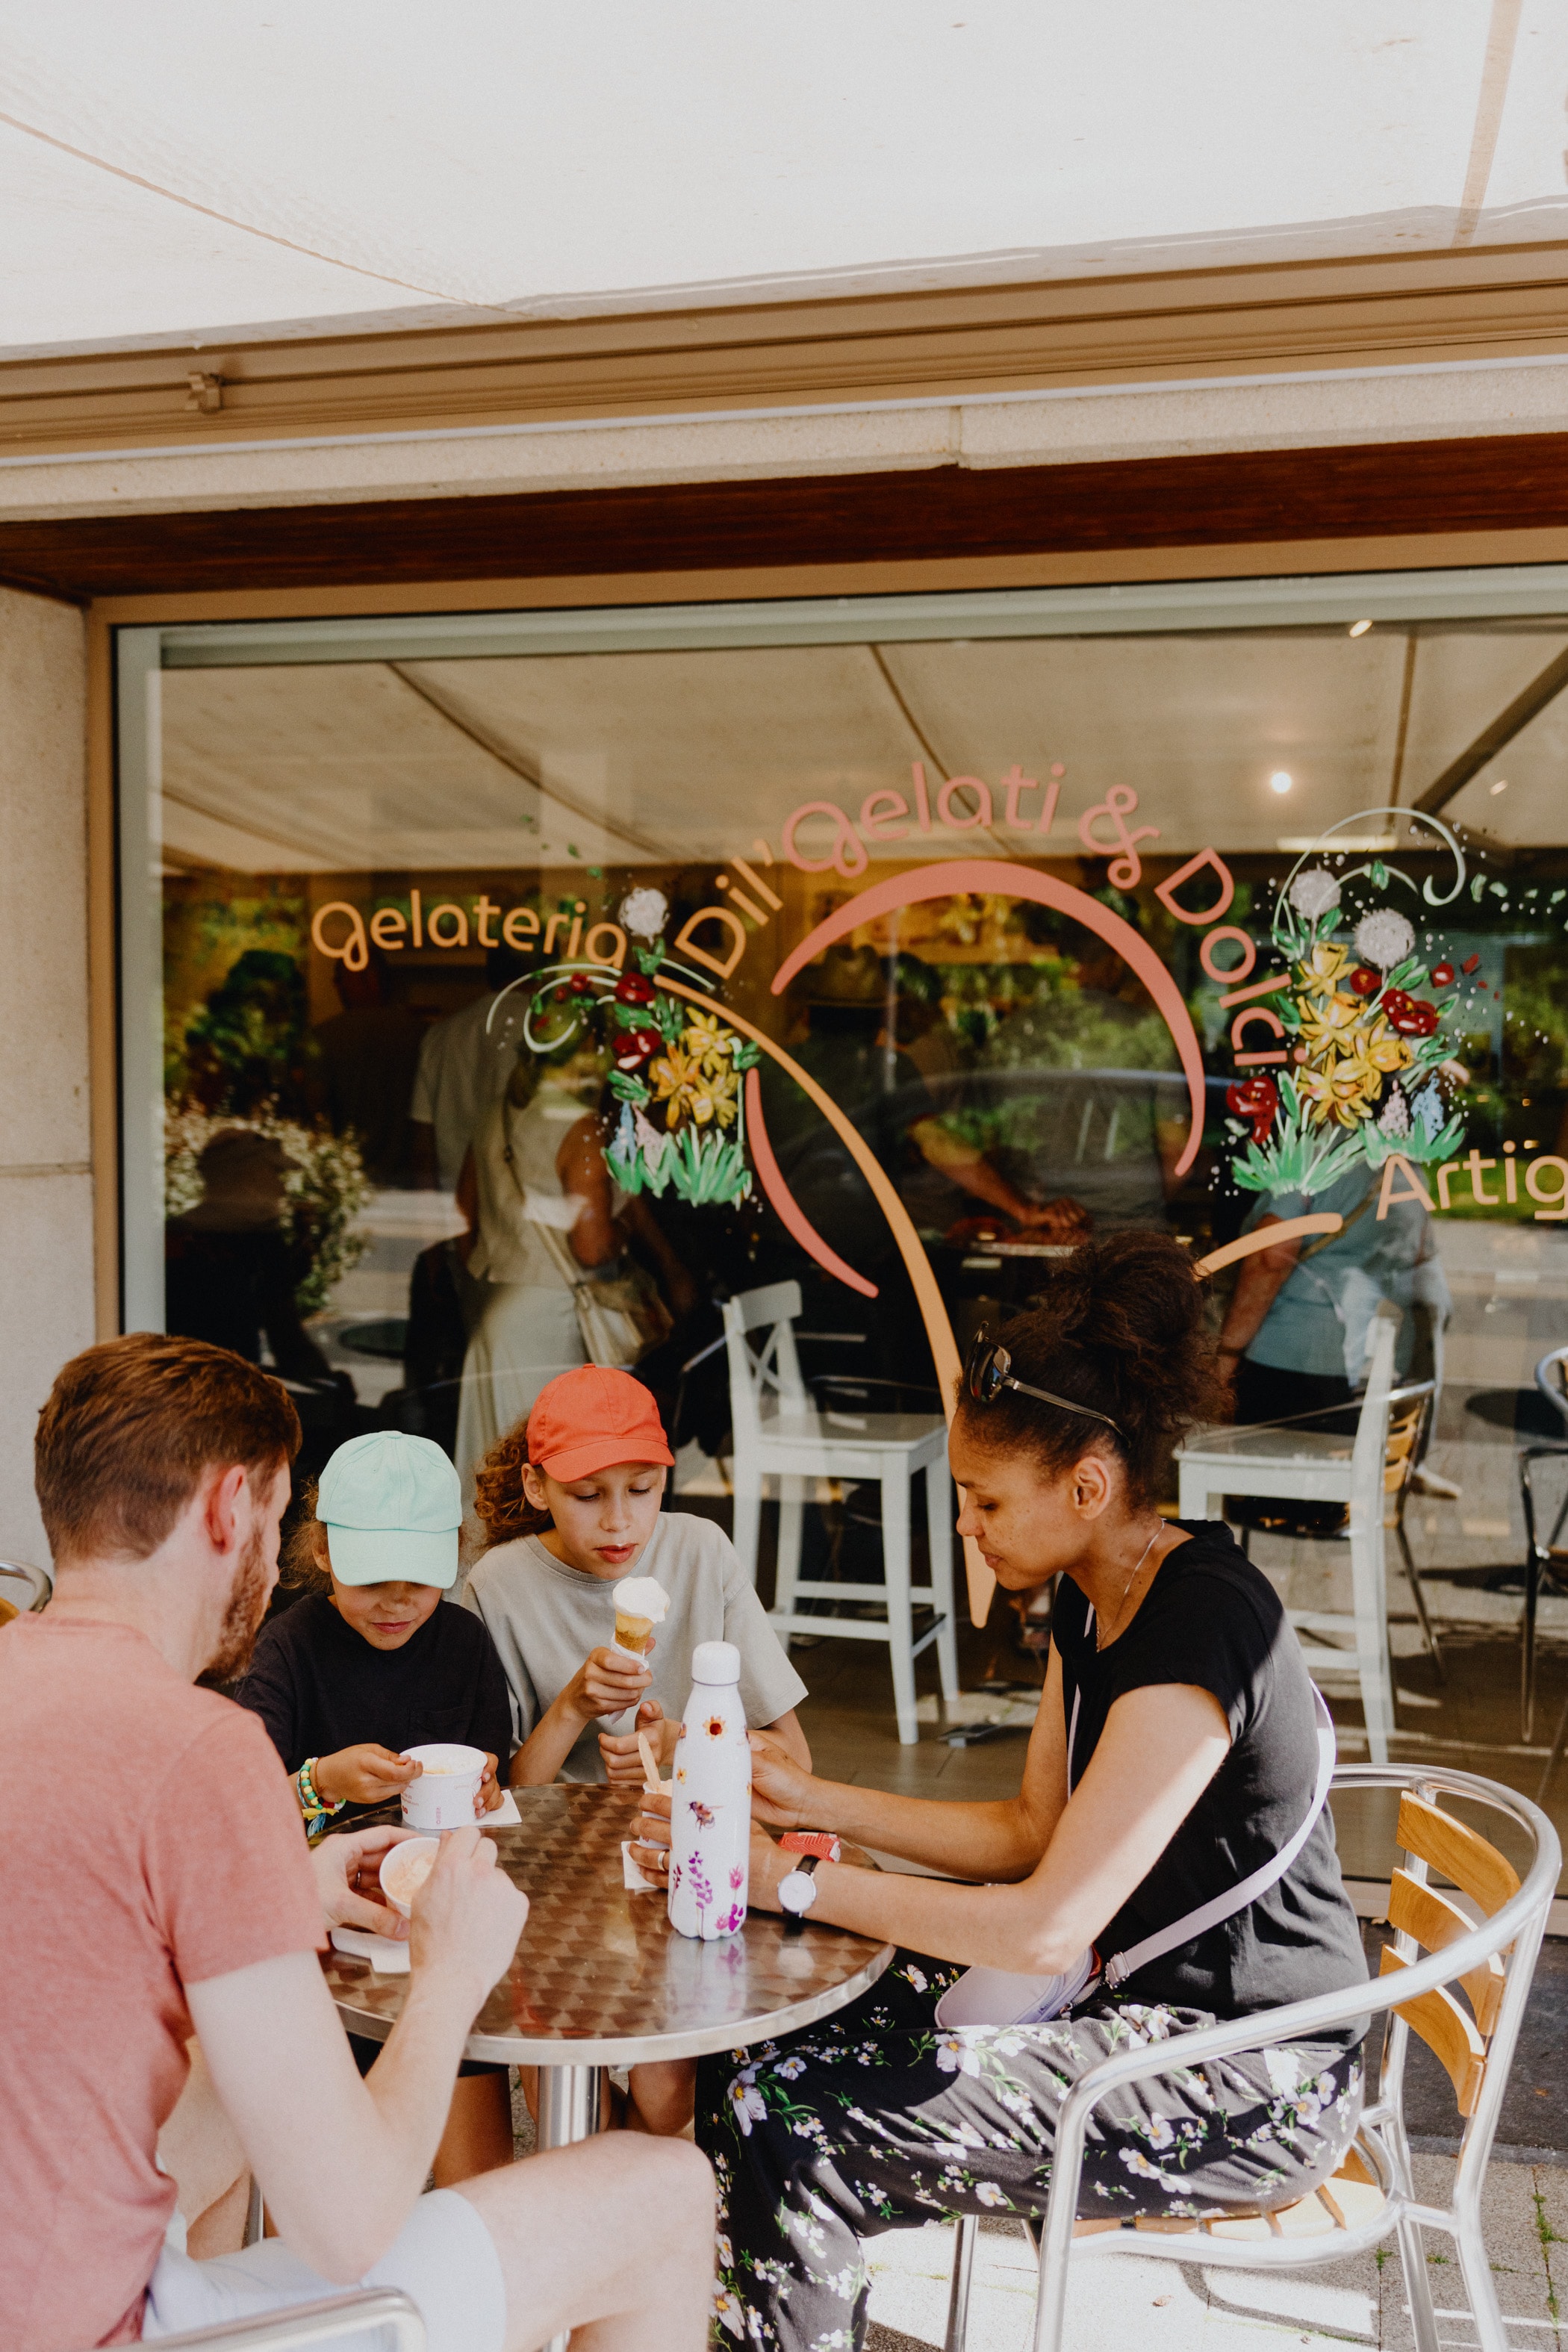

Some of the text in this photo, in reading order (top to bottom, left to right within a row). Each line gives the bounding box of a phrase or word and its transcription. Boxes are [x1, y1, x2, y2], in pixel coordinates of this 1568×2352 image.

[1077, 783, 1161, 890] &
[1154, 846, 1307, 1066] Dolci
[1376, 1140, 1568, 1221] Artig
